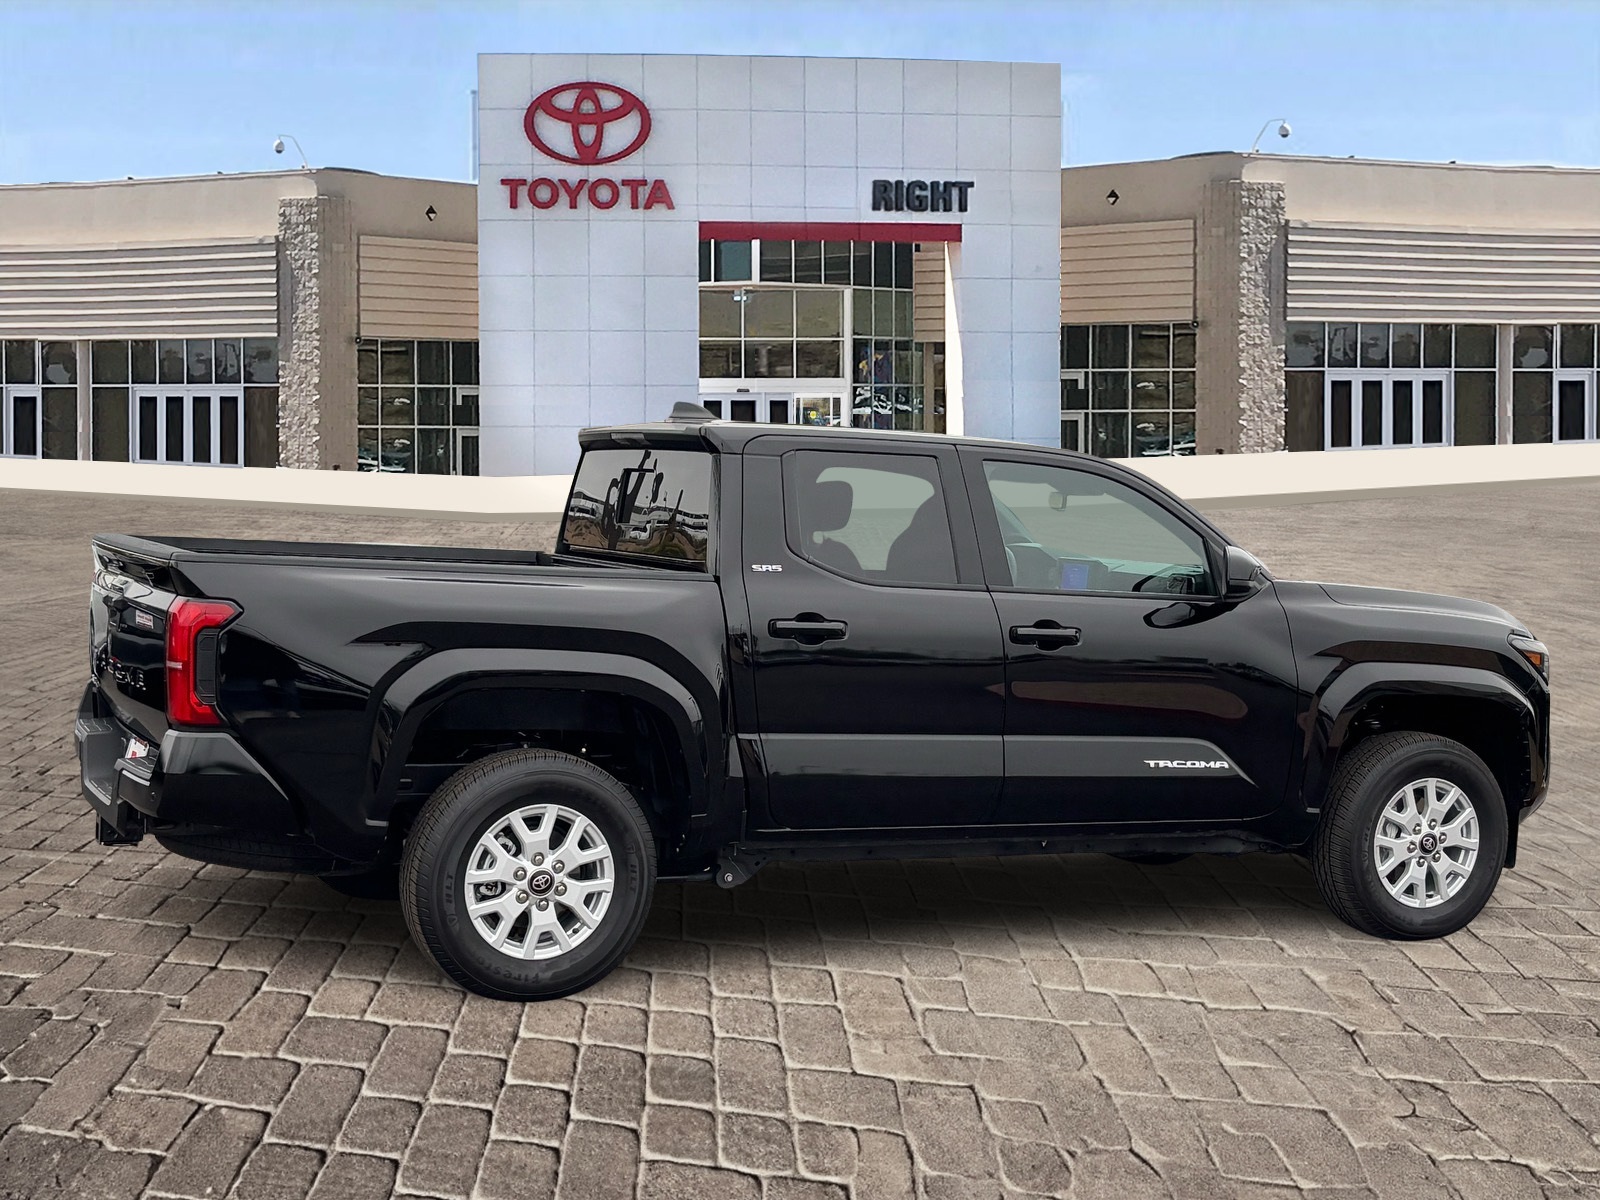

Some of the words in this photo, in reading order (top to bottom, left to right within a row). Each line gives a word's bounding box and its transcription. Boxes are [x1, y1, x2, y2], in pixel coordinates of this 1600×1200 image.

[500, 177, 676, 210] TOYOTA
[872, 180, 975, 212] RIGHT
[751, 564, 783, 572] SR5
[1143, 760, 1230, 769] TACOMA
